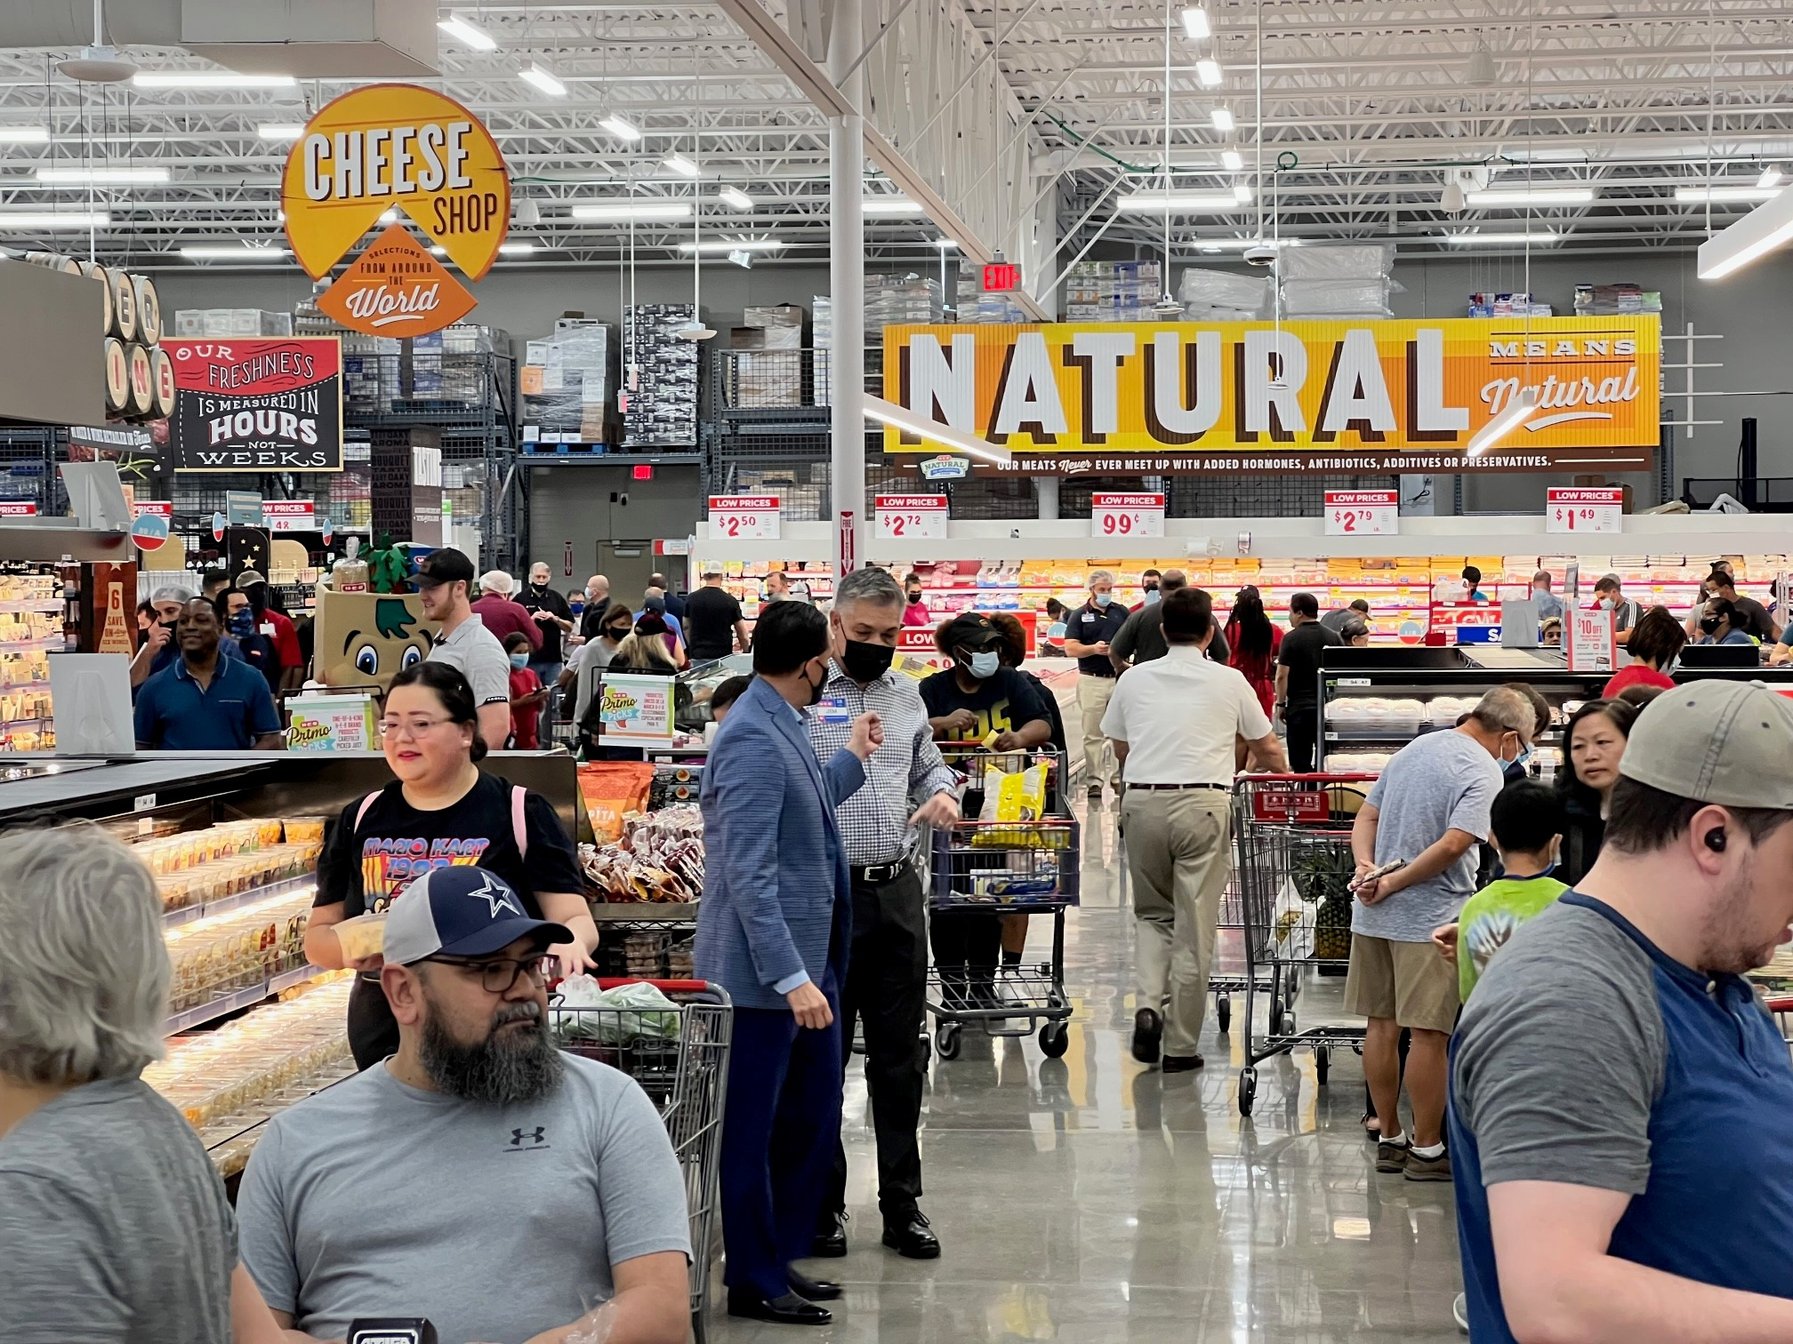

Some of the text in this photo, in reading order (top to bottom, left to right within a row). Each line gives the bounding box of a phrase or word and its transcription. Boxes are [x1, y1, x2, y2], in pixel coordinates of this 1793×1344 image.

[303, 122, 472, 201] CHEESE
[433, 193, 497, 235] SHOP
[369, 247, 421, 259] SELECTIONS
[361, 263, 432, 274] FROM AROUND
[389, 276, 403, 285] THE
[984, 265, 1014, 290] EXIT
[345, 284, 440, 319] World
[176, 345, 234, 361] OUR
[1489, 340, 1635, 358] MEANS
[208, 352, 314, 389] FRESHNESS
[901, 328, 1470, 444] NATURAL
[198, 389, 319, 417] IS MEASURED IN
[209, 410, 318, 446] HOURS
[248, 441, 276, 449] NOT
[196, 452, 326, 467] WEEKS
[997, 456, 1552, 472] OUR MEATS Never EVER MEET UP WITH ADDED HORMONES, ANTIBIOTICS, ADDITIVES OR PRESERVATIVES.
[716, 499, 771, 507] LOW PRICES
[906, 498, 938, 506] PRICES
[1333, 494, 1354, 502] LOW
[274, 504, 305, 512] PRICES
[112, 589, 119, 610] 6
[107, 616, 123, 625] SAVE
[1593, 625, 1603, 634] OFF
[906, 633, 935, 644] LOW
[600, 696, 637, 711] Primo
[608, 709, 632, 720] PICKS
[287, 726, 332, 747] Primo
[588, 810, 615, 819] PITA
[363, 837, 490, 857] MARIO KART
